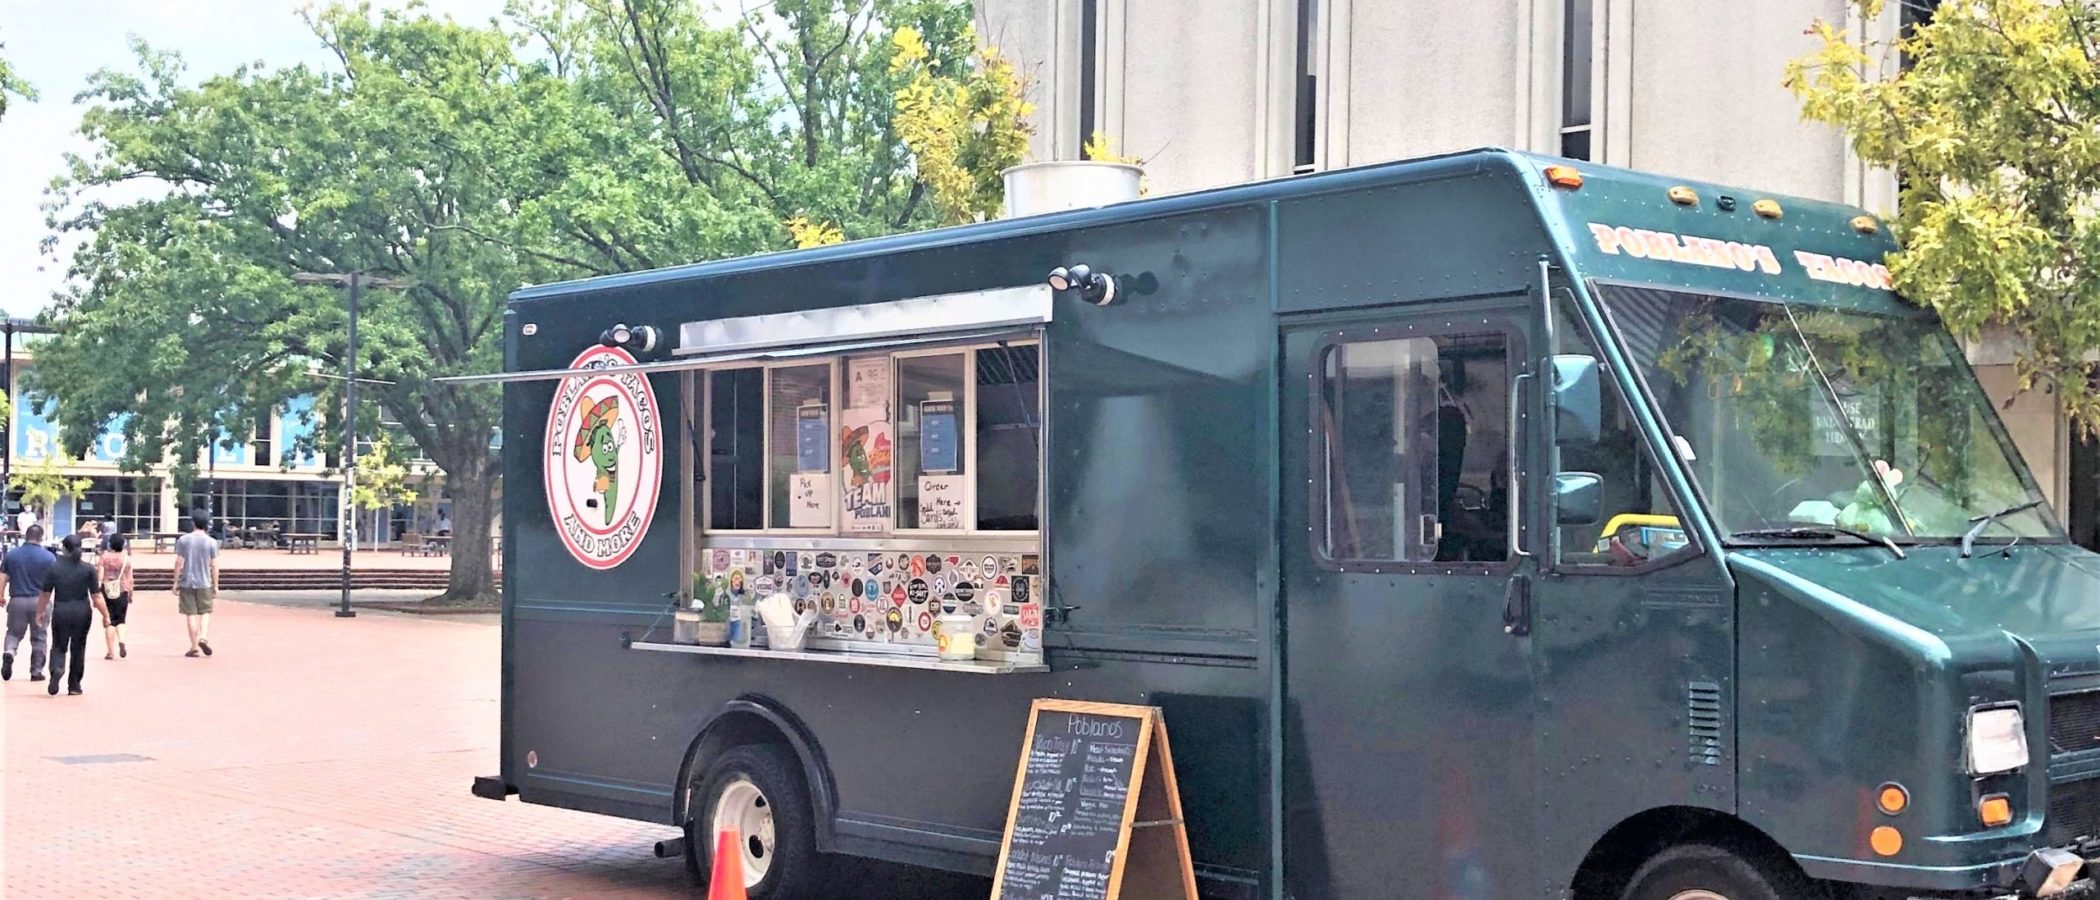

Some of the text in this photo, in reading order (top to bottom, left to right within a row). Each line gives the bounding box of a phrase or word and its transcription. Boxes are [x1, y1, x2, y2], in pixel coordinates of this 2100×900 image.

[620, 372, 655, 455] TACOS
[1816, 416, 1875, 430] UNDRAD
[845, 481, 887, 511] TEAM
[564, 511, 642, 557] AND MORE
[1068, 714, 1123, 738] Poblanos
